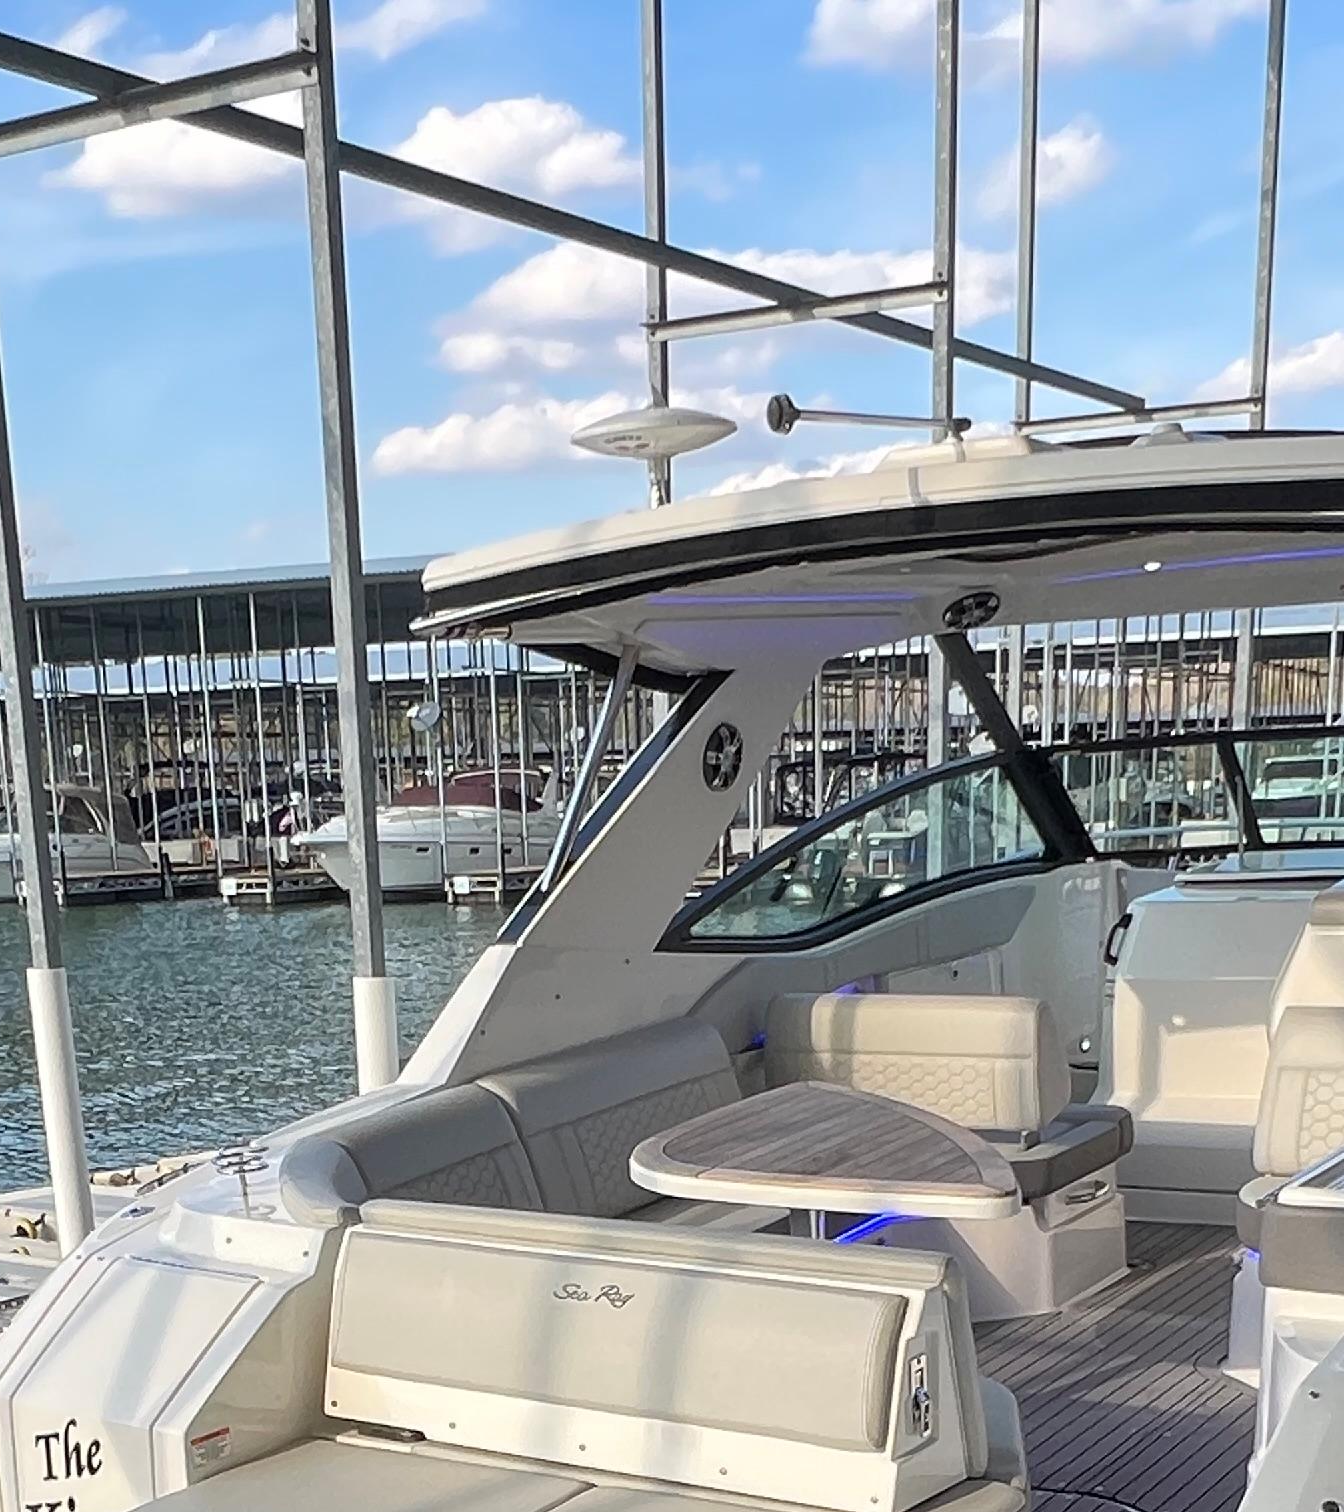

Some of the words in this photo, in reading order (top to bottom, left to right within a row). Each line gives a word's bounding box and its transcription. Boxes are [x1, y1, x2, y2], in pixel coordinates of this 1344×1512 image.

[553, 1283, 592, 1301] Sea
[594, 1284, 635, 1309] Ray
[34, 1418, 103, 1481] The
